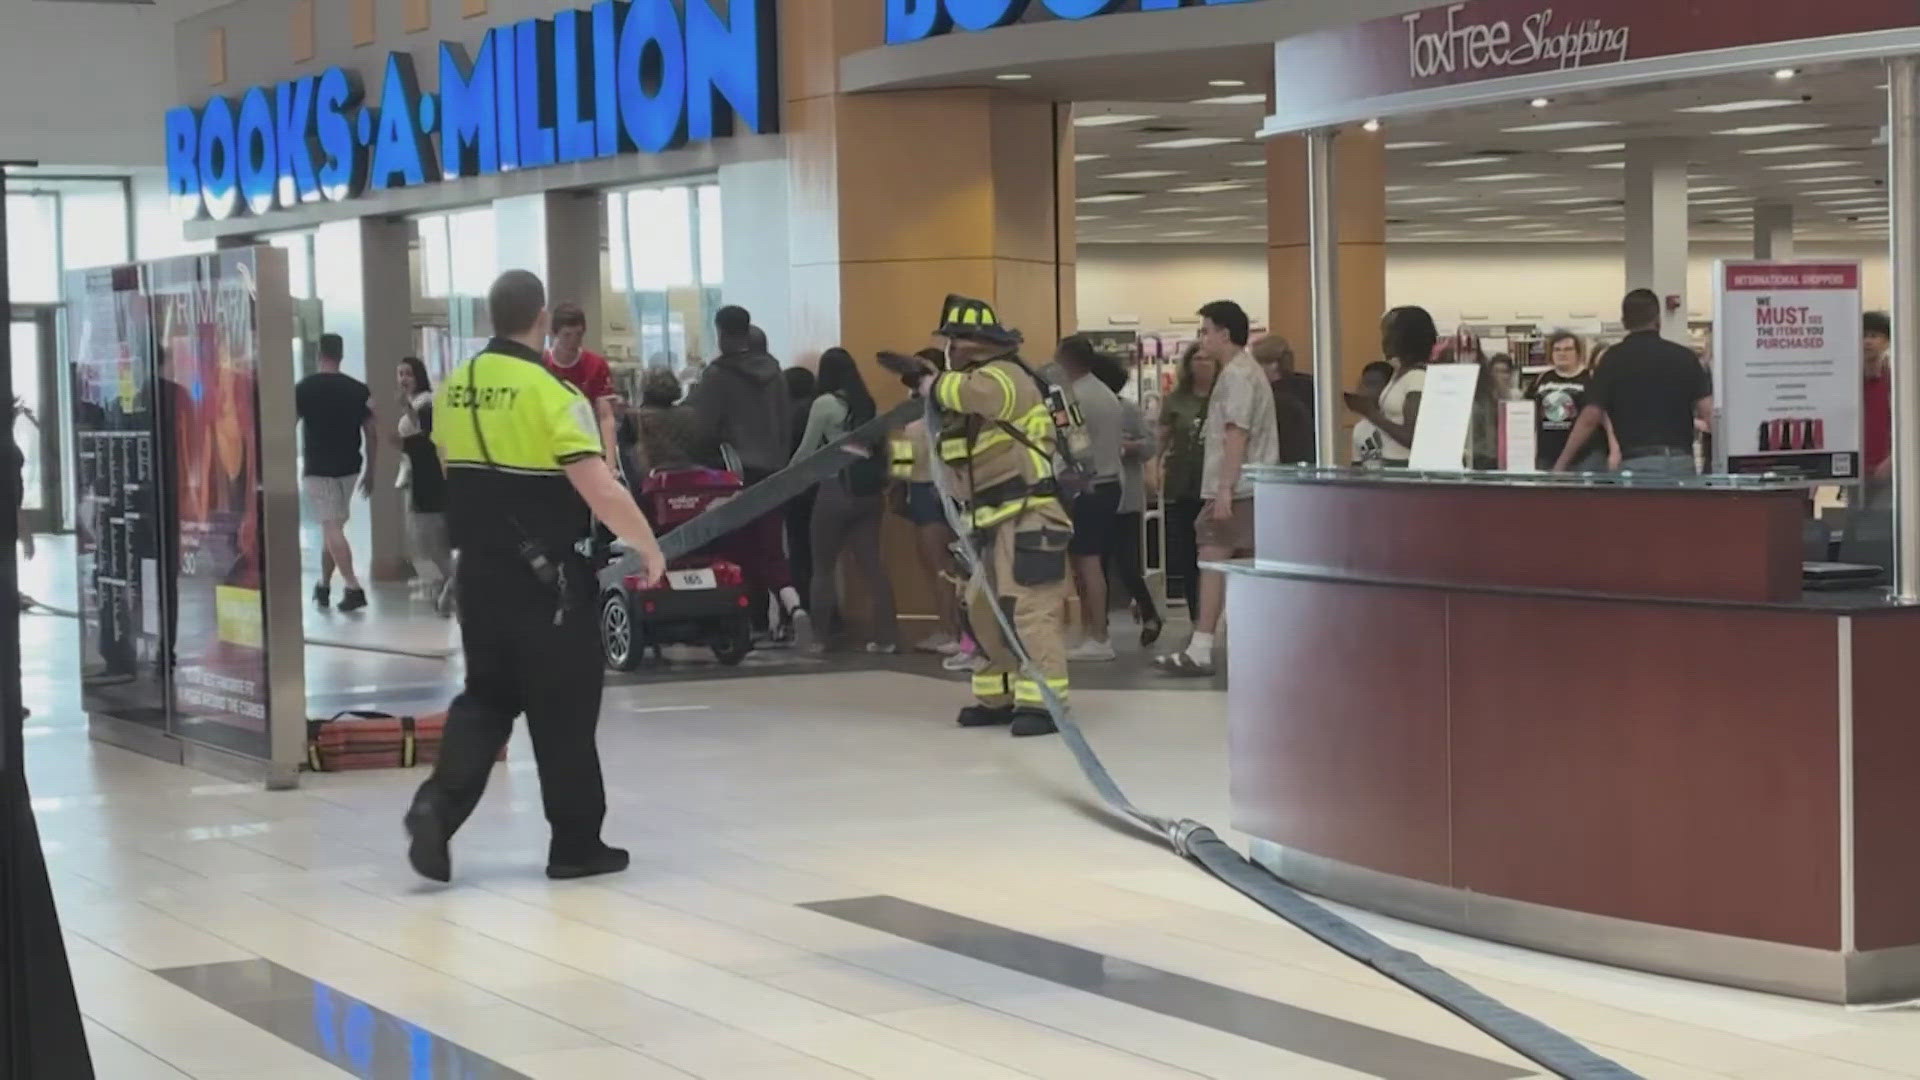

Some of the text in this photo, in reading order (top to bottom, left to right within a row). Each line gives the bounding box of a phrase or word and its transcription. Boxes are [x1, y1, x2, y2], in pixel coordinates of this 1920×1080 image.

[1403, 4, 1630, 78] TaxFree Shopping
[1734, 273, 1844, 287] INTERNATIONAL SHOPPERS
[1756, 296, 1771, 306] WE
[1756, 307, 1809, 325] MUST
[1756, 325, 1824, 337] THE ITEMS YOU
[1756, 337, 1825, 350] PURCHASED
[448, 385, 520, 410] SECURITY
